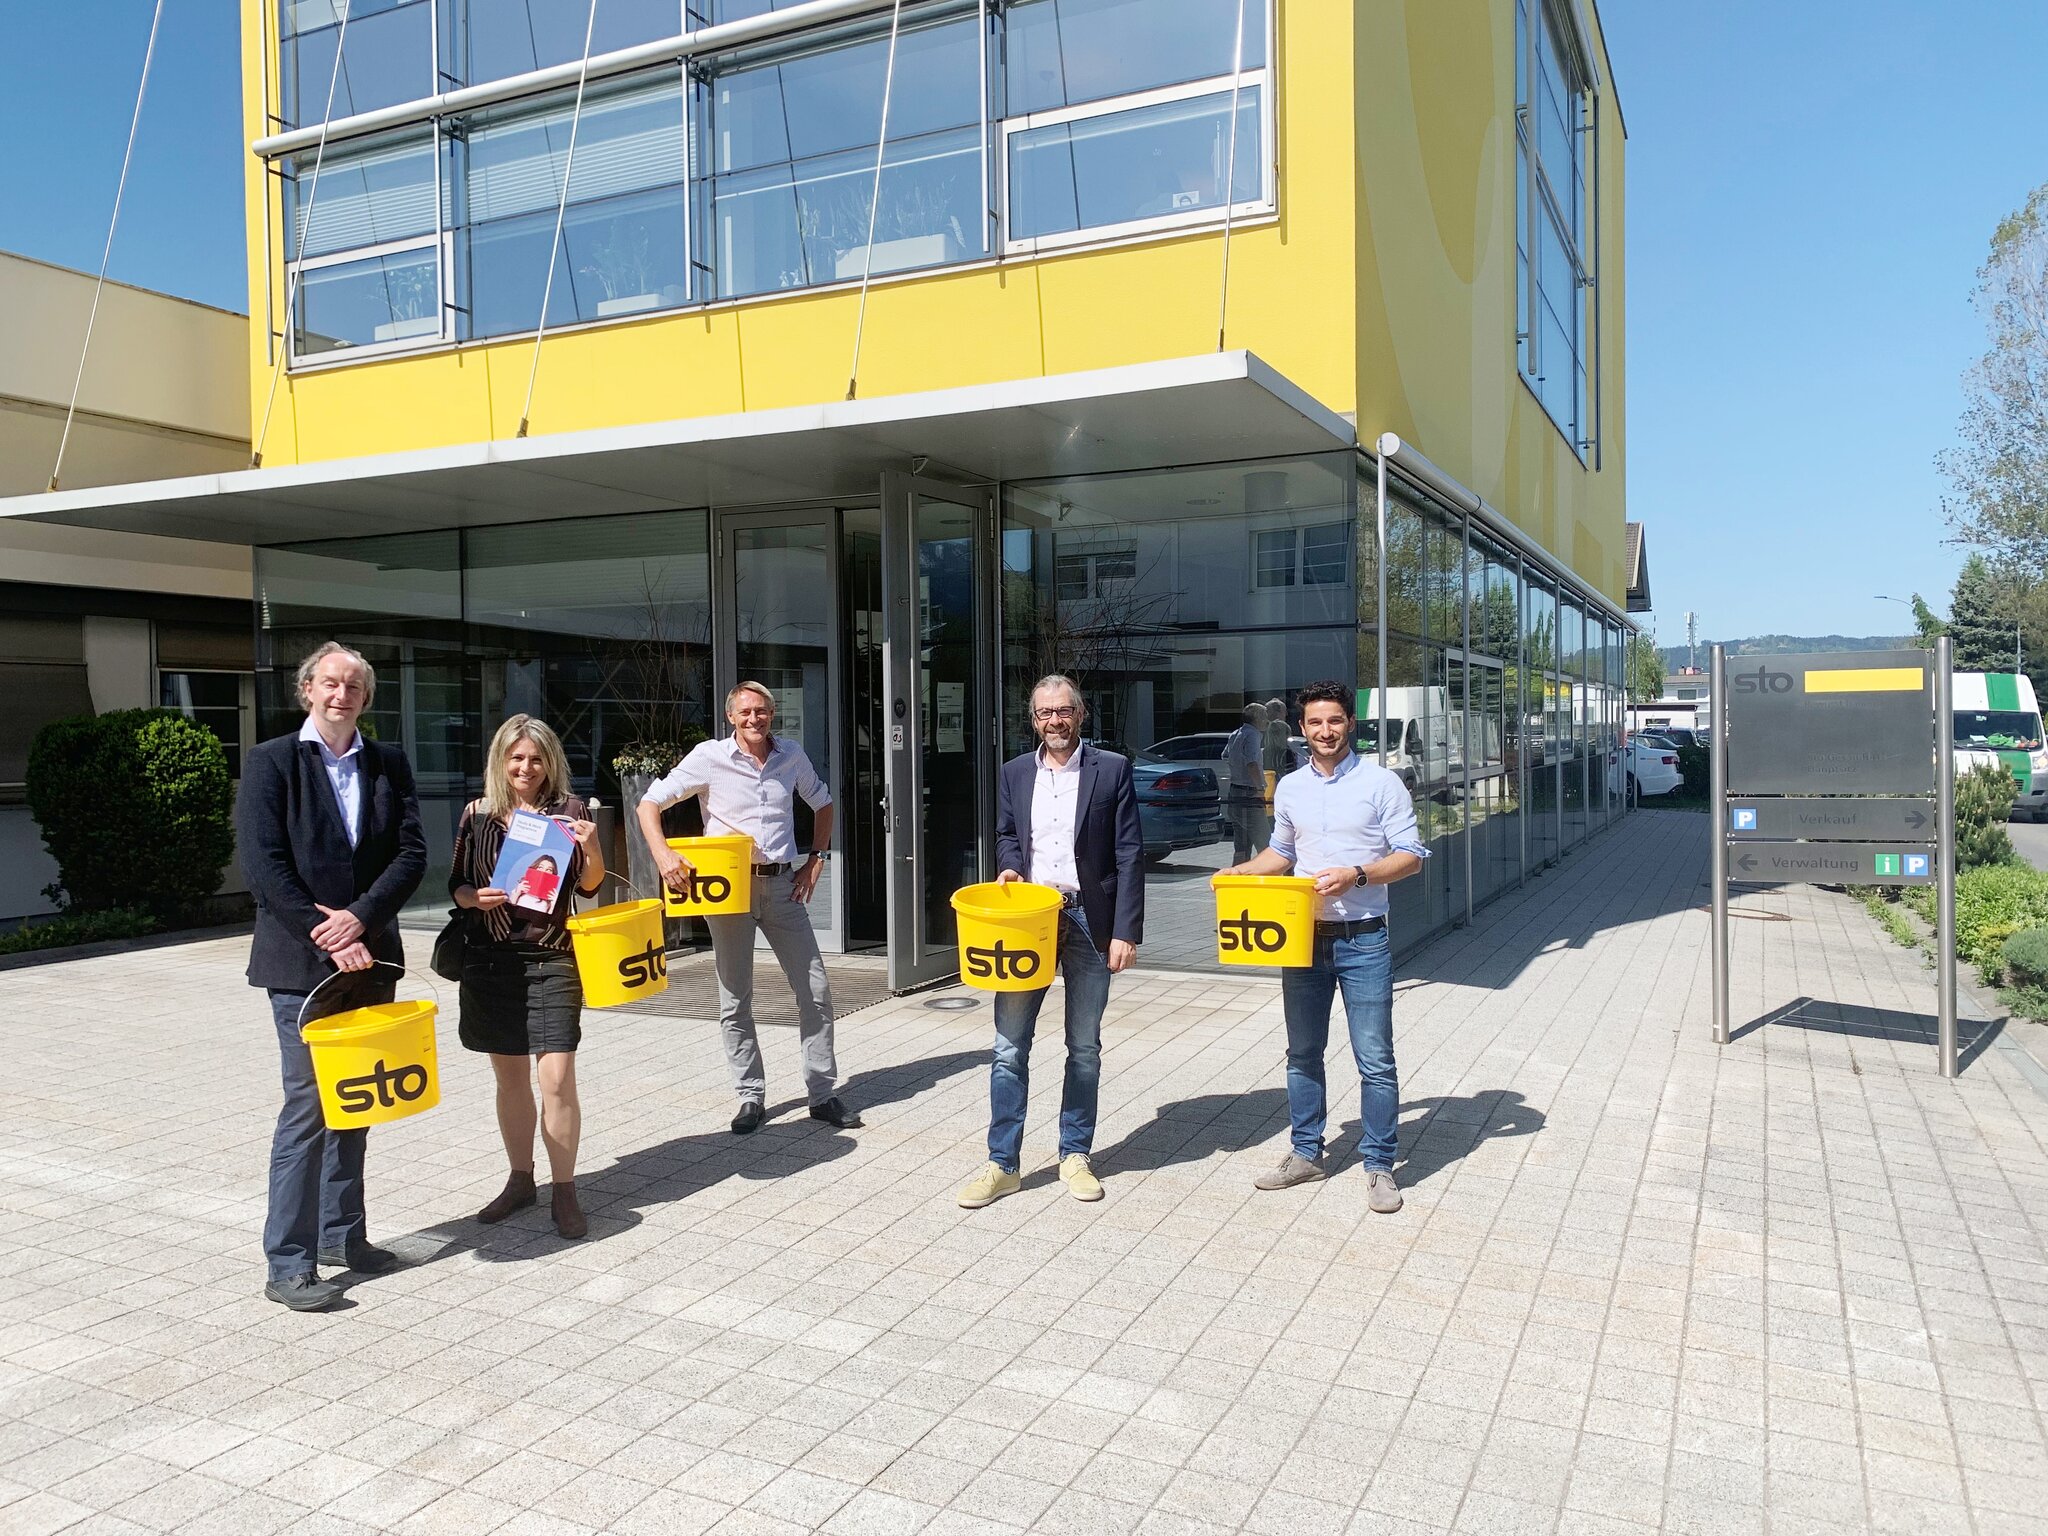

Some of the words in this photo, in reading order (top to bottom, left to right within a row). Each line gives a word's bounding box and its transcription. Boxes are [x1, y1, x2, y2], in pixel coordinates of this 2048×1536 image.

[1734, 665, 1794, 694] sto
[1738, 811, 1753, 827] P
[1800, 813, 1857, 826] Verkauf
[1772, 857, 1859, 872] Verwaltung
[1909, 857, 1925, 873] P
[667, 868, 731, 904] sto
[1219, 908, 1287, 952] sto
[966, 939, 1040, 980] sto
[336, 1059, 428, 1113] sto
